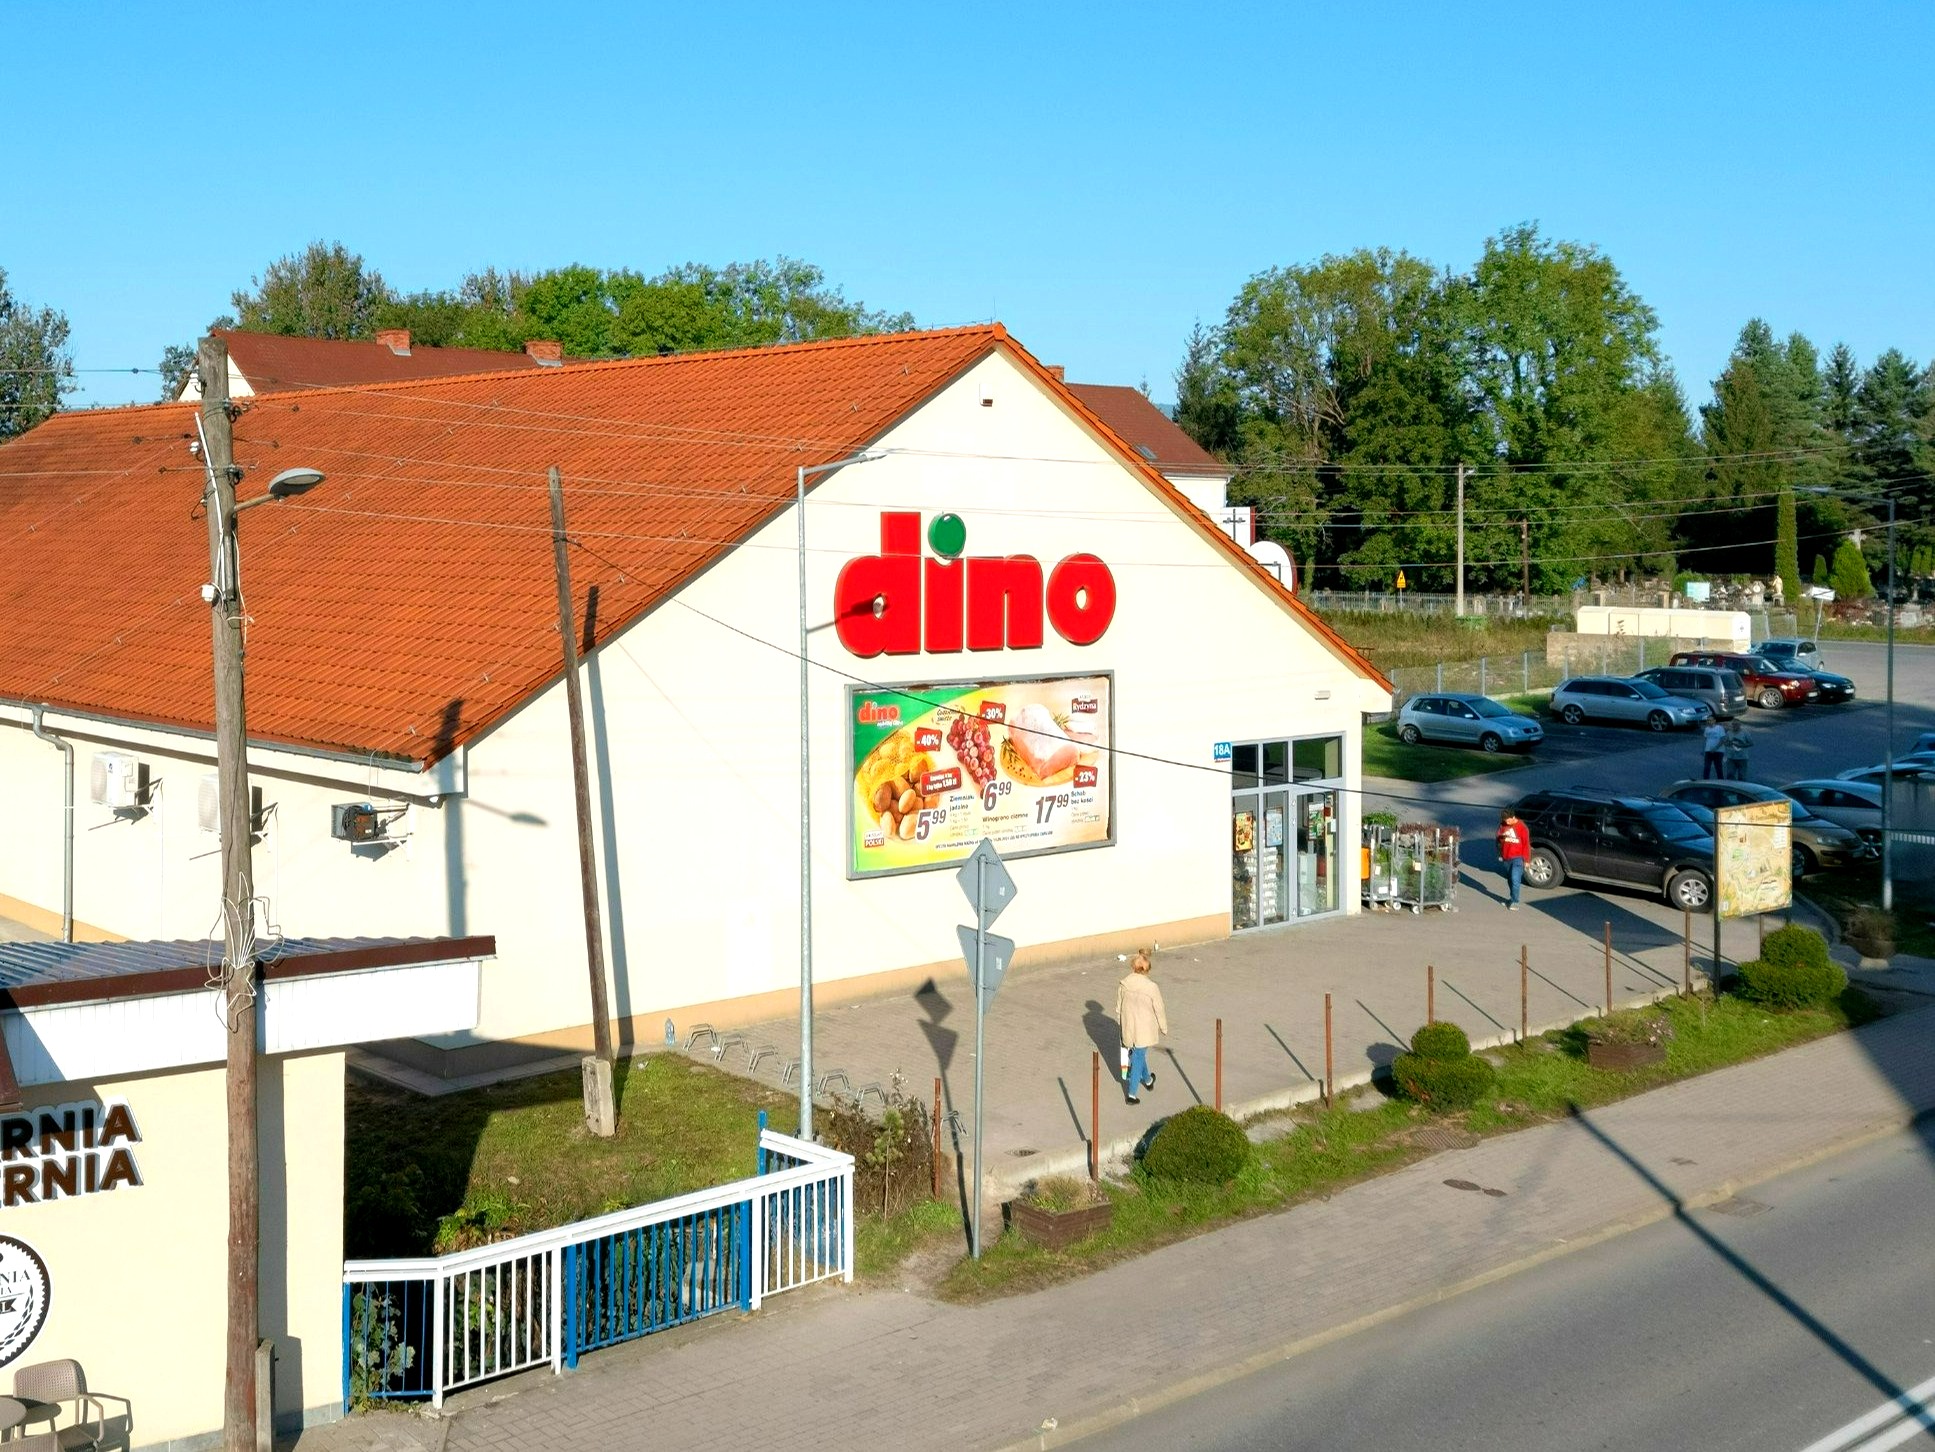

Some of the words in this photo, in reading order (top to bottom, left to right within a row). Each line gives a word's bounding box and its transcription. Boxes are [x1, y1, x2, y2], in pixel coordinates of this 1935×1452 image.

[834, 511, 1116, 659] dino
[858, 701, 899, 724] dino
[1215, 743, 1230, 756] 18A
